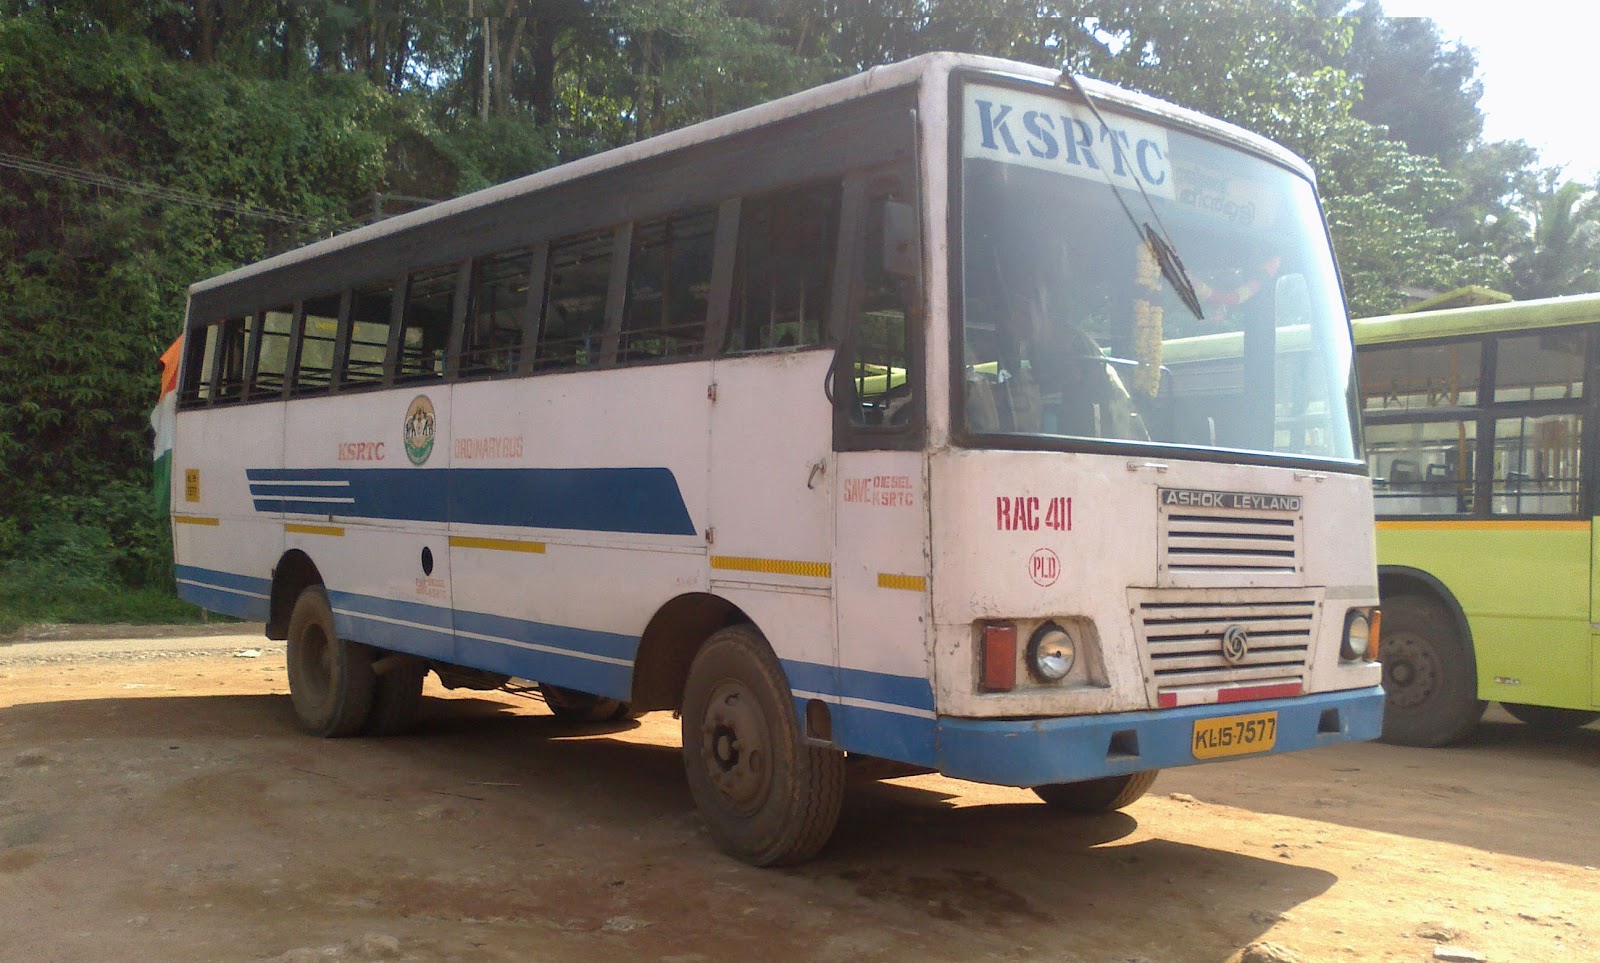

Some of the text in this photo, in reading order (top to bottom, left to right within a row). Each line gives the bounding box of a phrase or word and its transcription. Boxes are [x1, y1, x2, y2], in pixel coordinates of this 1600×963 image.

[975, 99, 1166, 186] KSRTC
[337, 442, 385, 461] KSRTC
[843, 476, 913, 502] SAVE DIESEL
[873, 491, 914, 507] KSRTC
[1166, 490, 1300, 510] ASHOK LEYLAND
[997, 496, 1072, 531] RAC 411
[1033, 556, 1056, 579] PLD
